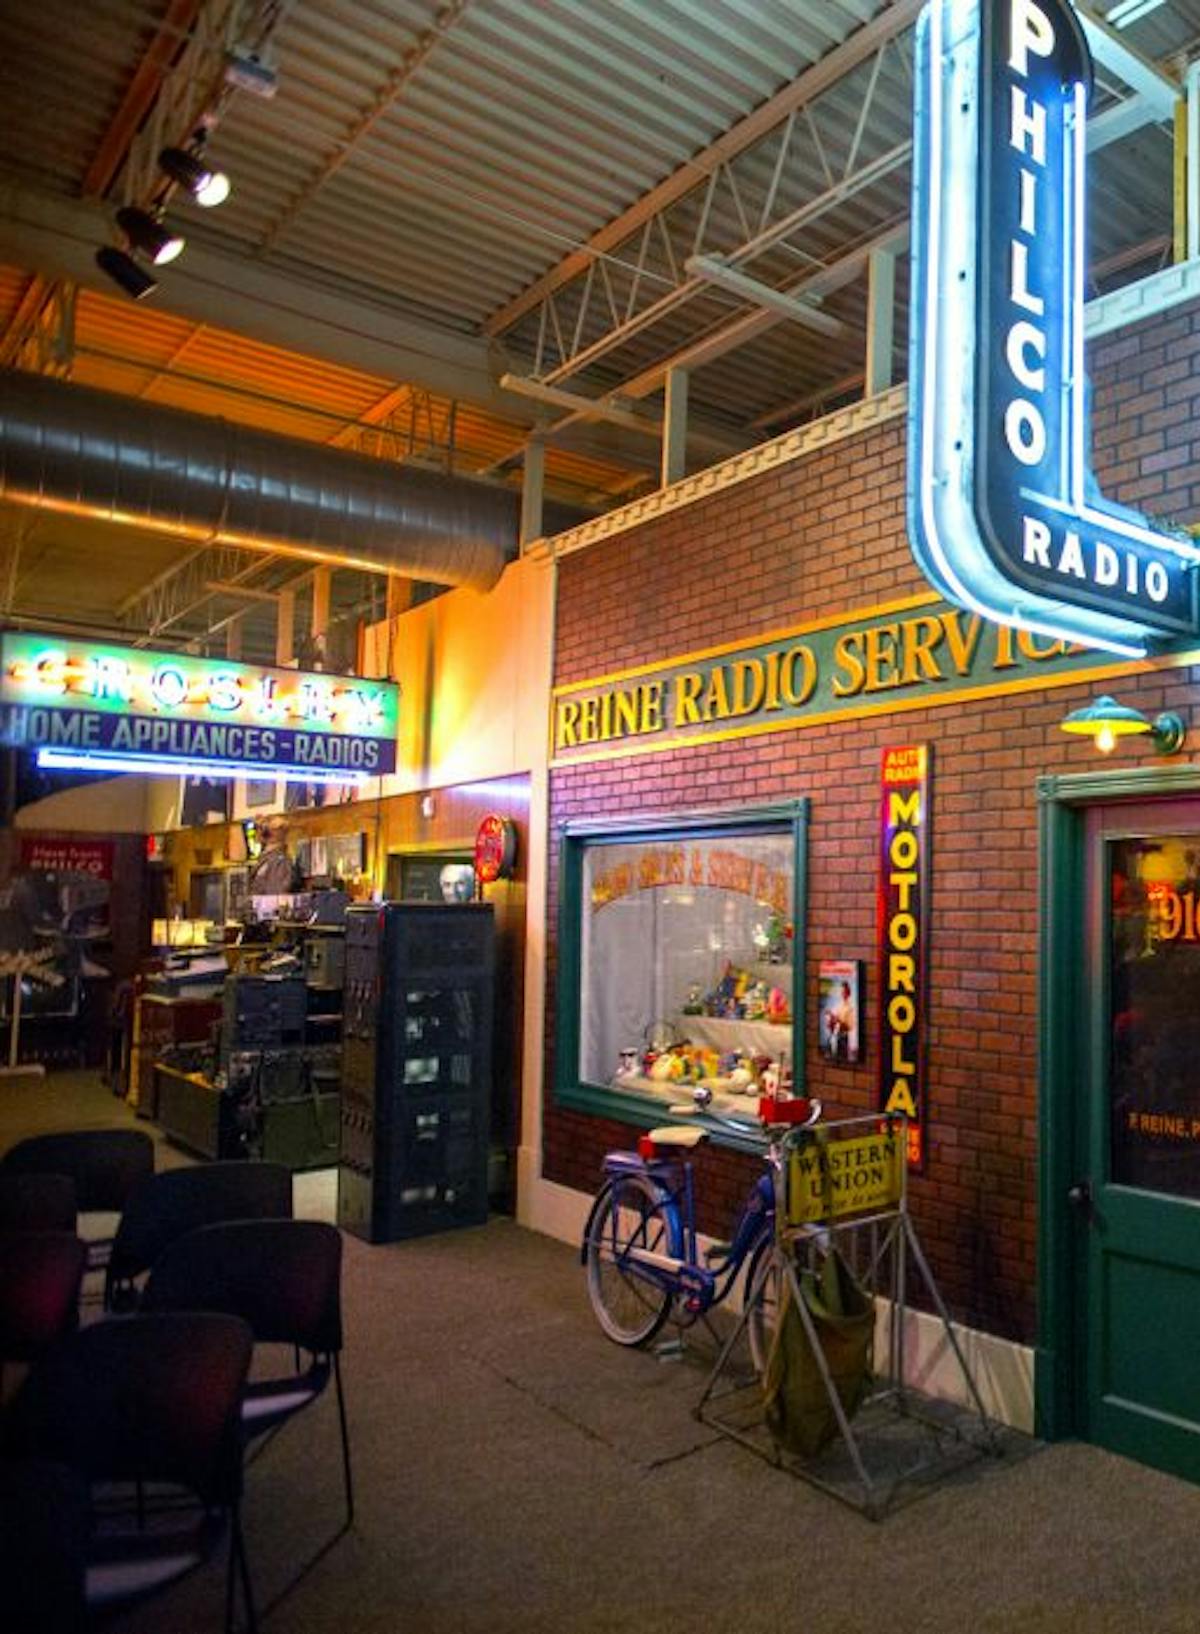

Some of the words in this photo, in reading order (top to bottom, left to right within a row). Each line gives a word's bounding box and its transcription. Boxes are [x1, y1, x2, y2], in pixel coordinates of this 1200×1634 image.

[1005, 0, 1056, 467] PHILCO
[1022, 515, 1169, 602] RADIO
[557, 680, 664, 749] REINE
[674, 645, 818, 728] RADIO
[831, 610, 1087, 697] SERVI
[9, 706, 100, 748] HOME
[886, 790, 919, 1119] MOTOROLA
[798, 1141, 896, 1177] WESTERN
[810, 1165, 883, 1198] UNION
